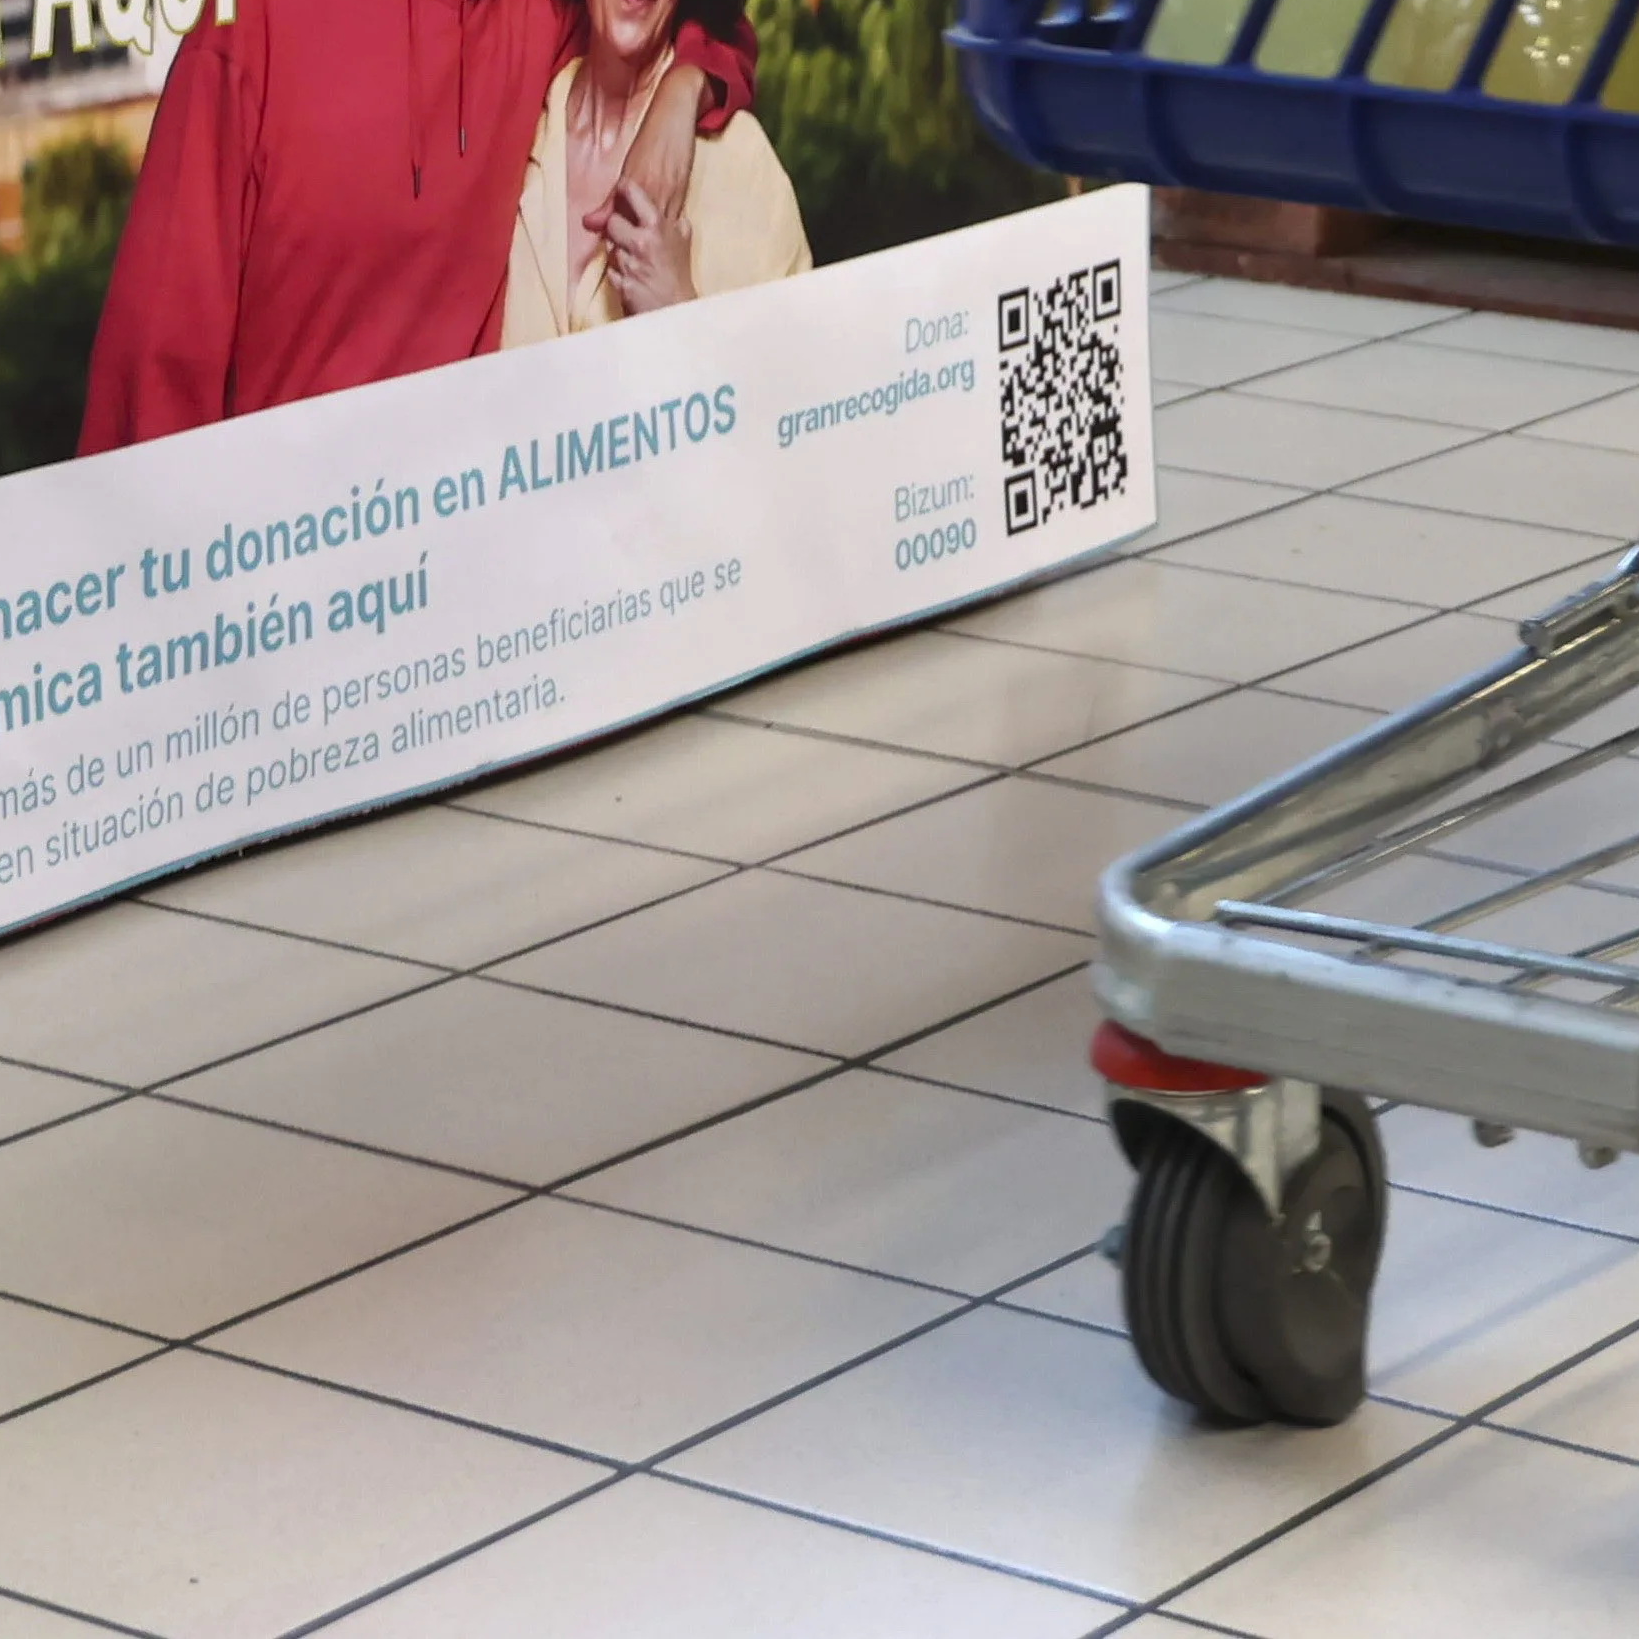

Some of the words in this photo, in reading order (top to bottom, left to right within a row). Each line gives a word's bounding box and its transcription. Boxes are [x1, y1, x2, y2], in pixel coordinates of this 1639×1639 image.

[905, 308, 969, 354] Dona:
[778, 360, 975, 448] granrecogida.org
[140, 547, 191, 598] tu
[207, 480, 420, 581] donación
[433, 466, 485, 518] en
[499, 385, 736, 501] ALIMENTOS
[895, 474, 974, 521] Bizum:
[895, 518, 977, 570] 00090
[67, 755, 104, 795] de
[116, 741, 154, 779] un
[166, 705, 260, 764] millón
[272, 693, 311, 733] de
[323, 648, 466, 726] personas
[476, 588, 652, 681] beneficiarias
[660, 575, 705, 627] que
[714, 557, 743, 591] se
[117, 595, 313, 693] también
[328, 553, 428, 634] aquí
[45, 790, 183, 866] situación
[195, 769, 234, 810] de
[246, 732, 380, 805] pobreza
[392, 681, 566, 753] alimentaria.
